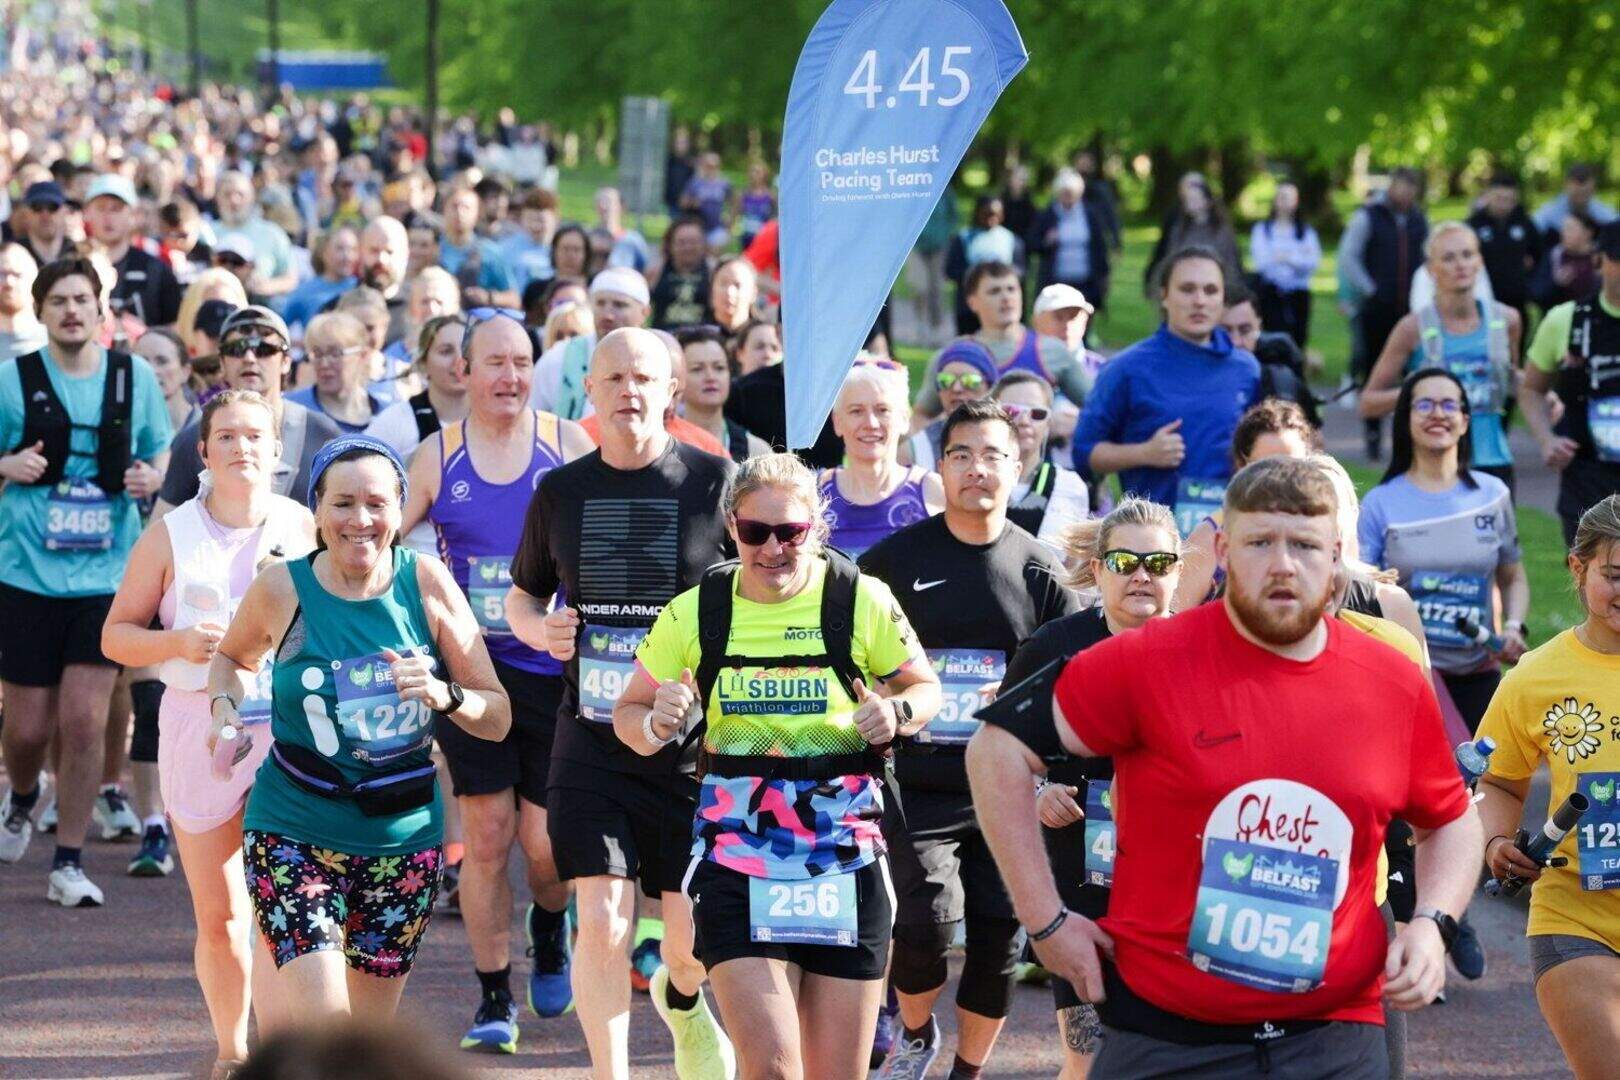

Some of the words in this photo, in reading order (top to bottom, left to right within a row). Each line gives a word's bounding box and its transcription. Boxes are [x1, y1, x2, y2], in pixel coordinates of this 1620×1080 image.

[843, 46, 971, 109] 4.45
[815, 146, 887, 168] Charles
[890, 144, 940, 165] Hurst
[821, 170, 882, 191] Pacing
[886, 168, 933, 186] Team
[48, 507, 112, 534] 3465
[945, 664, 994, 674] BELFAST
[726, 702, 784, 713] triathlon
[790, 702, 820, 713] club
[1238, 794, 1319, 844] Chest
[1582, 823, 1620, 849] 12
[1251, 867, 1321, 892] BELFAST
[769, 883, 839, 918] 256
[1206, 902, 1321, 965] 1054
